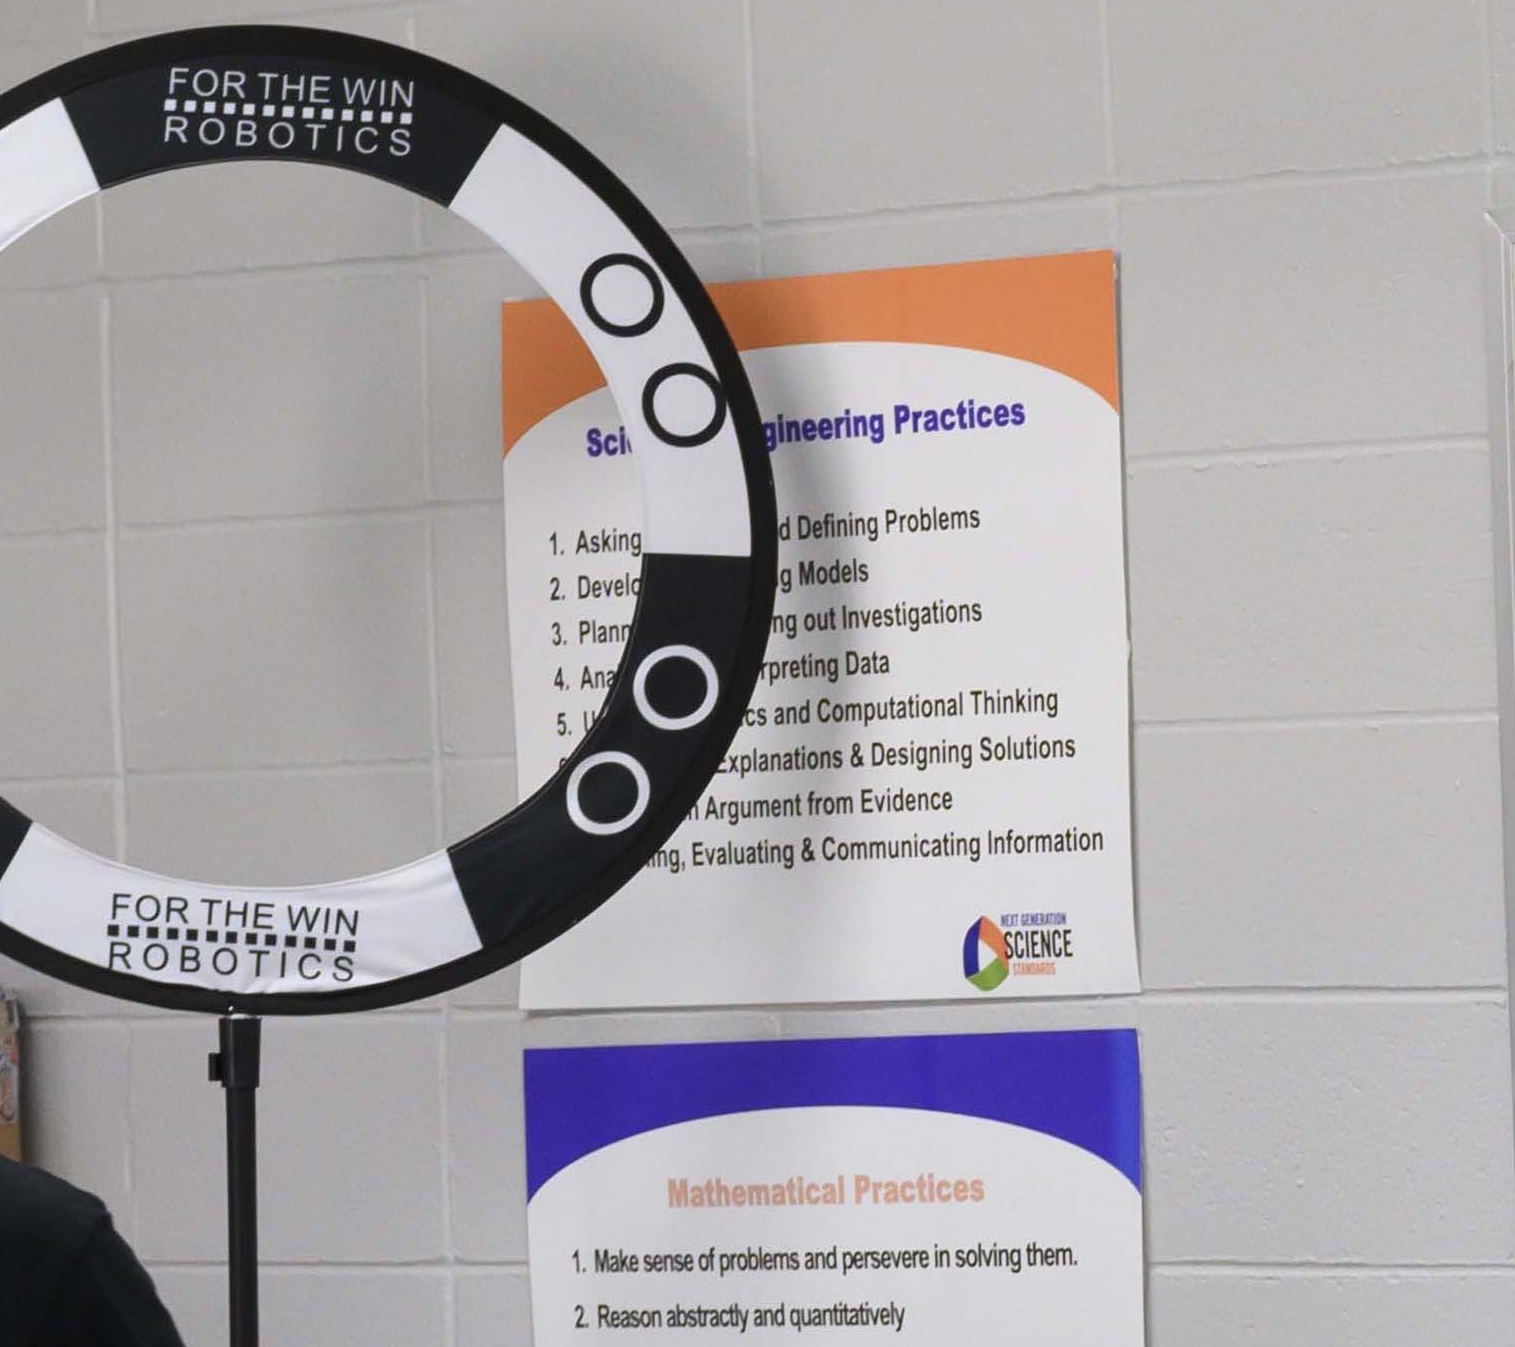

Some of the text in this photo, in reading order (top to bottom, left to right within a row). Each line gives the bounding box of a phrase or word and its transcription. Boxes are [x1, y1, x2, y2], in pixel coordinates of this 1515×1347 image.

[169, 67, 415, 108] FOR THE WIN
[164, 116, 412, 156] ROBOTICS
[763, 399, 1025, 451] gineering Practices
[550, 532, 564, 555] 1.
[576, 528, 641, 557] Asking
[797, 512, 878, 541] Defining
[886, 507, 980, 533] Problems
[550, 577, 565, 601] 2.
[578, 572, 641, 598] Develo
[799, 558, 868, 586] Models
[552, 622, 567, 646] 3.
[579, 620, 631, 643] Plann
[804, 607, 836, 631] out
[842, 600, 982, 632] Investigations
[554, 667, 569, 690] 4.
[761, 656, 838, 684] rpreting
[845, 651, 889, 675] Data
[557, 713, 571, 736] 5.
[774, 699, 810, 725] and
[817, 692, 963, 727] Computational
[970, 688, 1058, 718] Thinking
[850, 743, 864, 767] &
[872, 739, 972, 771] Designing
[980, 735, 1075, 761] Solutions
[705, 793, 802, 825] Argument
[807, 790, 853, 816] from
[861, 788, 952, 813] Evidence
[692, 839, 794, 869] Evaluating
[801, 837, 815, 862] &
[822, 832, 980, 862] Communicating
[988, 827, 1103, 854] Information
[111, 893, 359, 936] FOR THE WIN
[1001, 914, 1019, 927] NEXT
[109, 941, 355, 982] ROBOTICS
[1003, 930, 1073, 959] SCIENCE
[668, 1173, 985, 1208] Mathematical Practices
[572, 1242, 1077, 1277] 1. Make sense of problems and persevere in solving them.
[575, 1302, 905, 1333] 2. Reason abstractly and quantitatively
